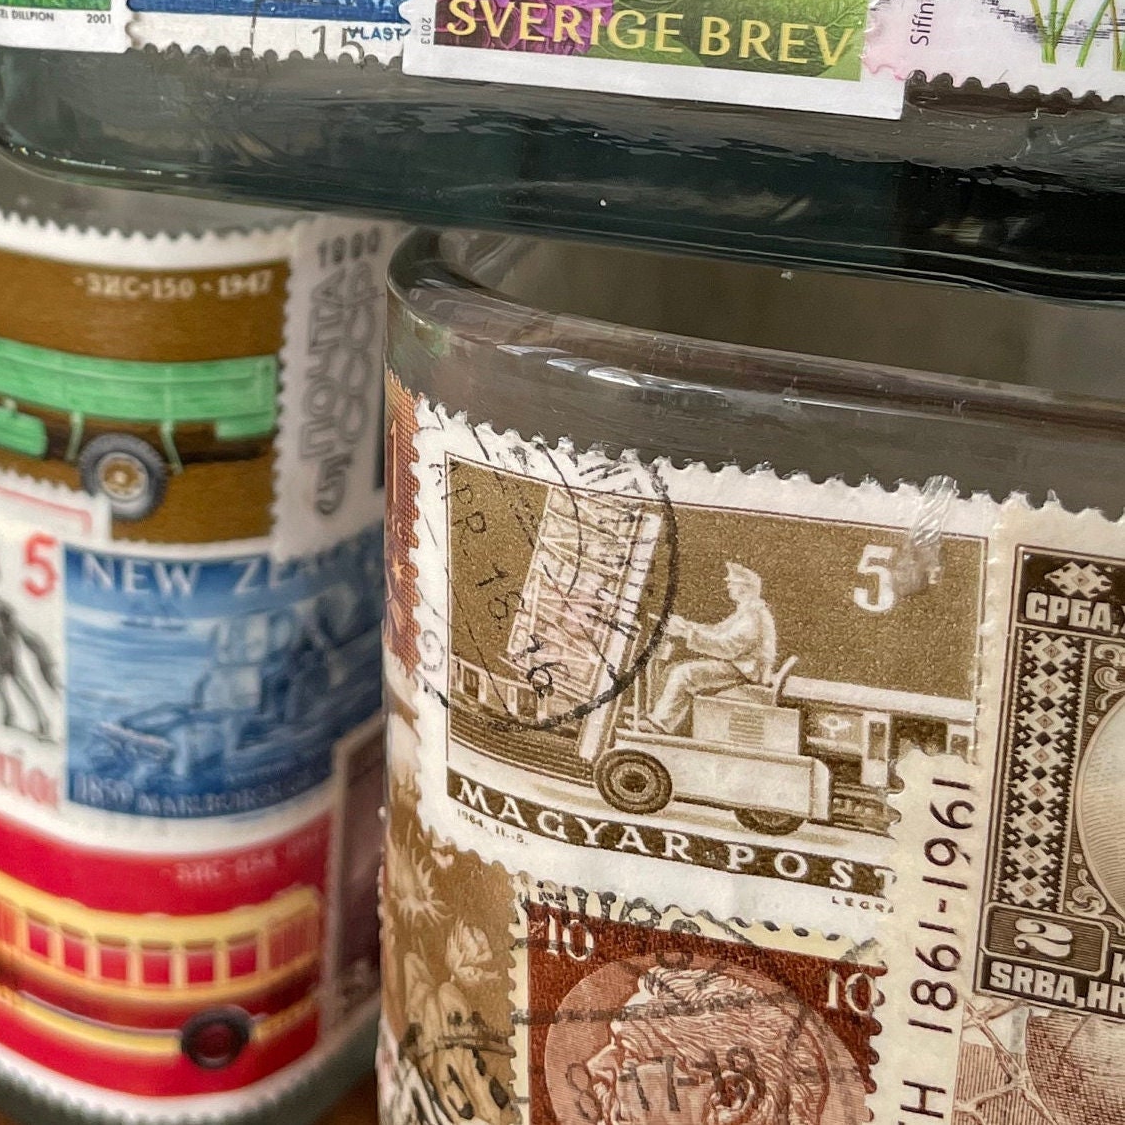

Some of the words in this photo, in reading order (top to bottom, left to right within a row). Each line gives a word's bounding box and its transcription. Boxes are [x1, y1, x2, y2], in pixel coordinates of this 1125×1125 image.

[86, 13, 112, 25] 2001
[420, 17, 433, 46] 2013
[698, 15, 855, 67] BREV
[23, 532, 58, 599] 5
[81, 550, 203, 599] NEW
[853, 544, 895, 613] 5
[454, 776, 694, 865] MAGYAR
[1013, 916, 1074, 958] 2
